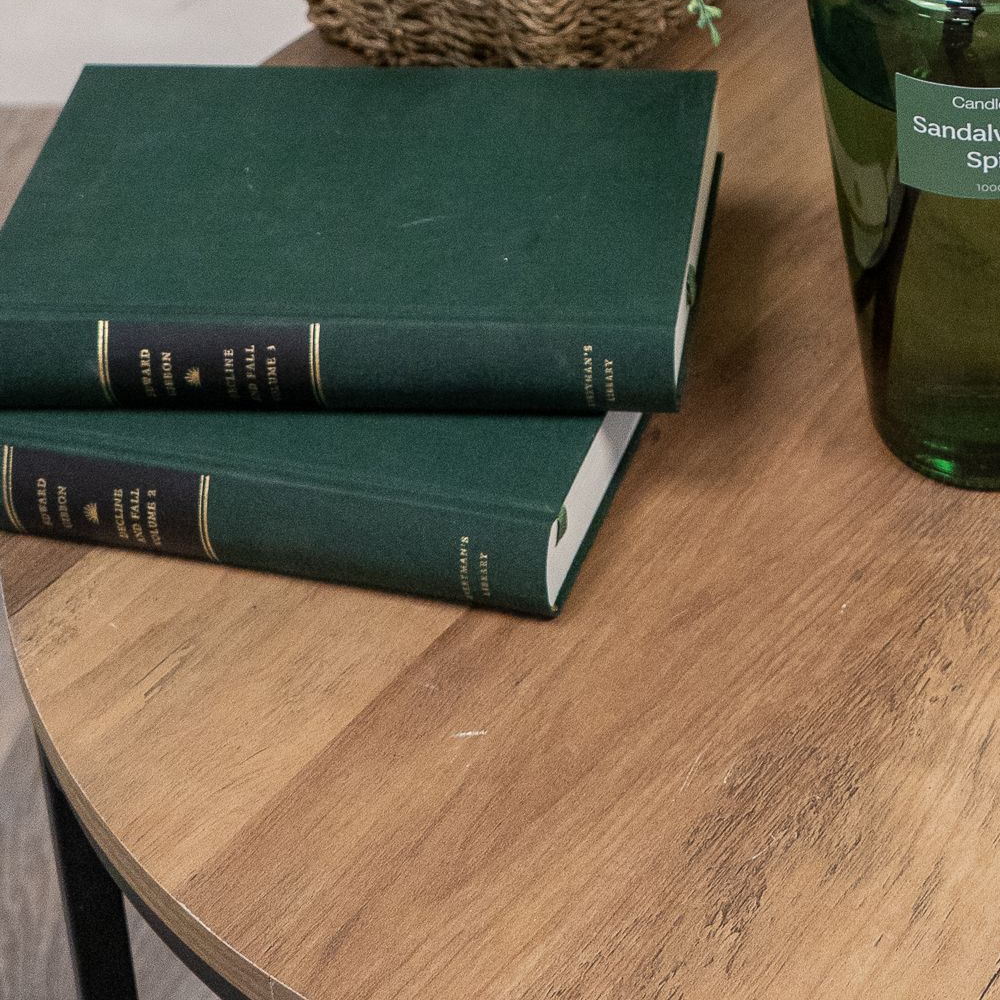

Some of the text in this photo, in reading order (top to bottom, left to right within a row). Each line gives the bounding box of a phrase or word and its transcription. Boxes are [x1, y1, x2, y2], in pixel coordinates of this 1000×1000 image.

[245, 345, 256, 378] FALL
[131, 488, 140, 519] FALL
[148, 490, 156, 498] 2
